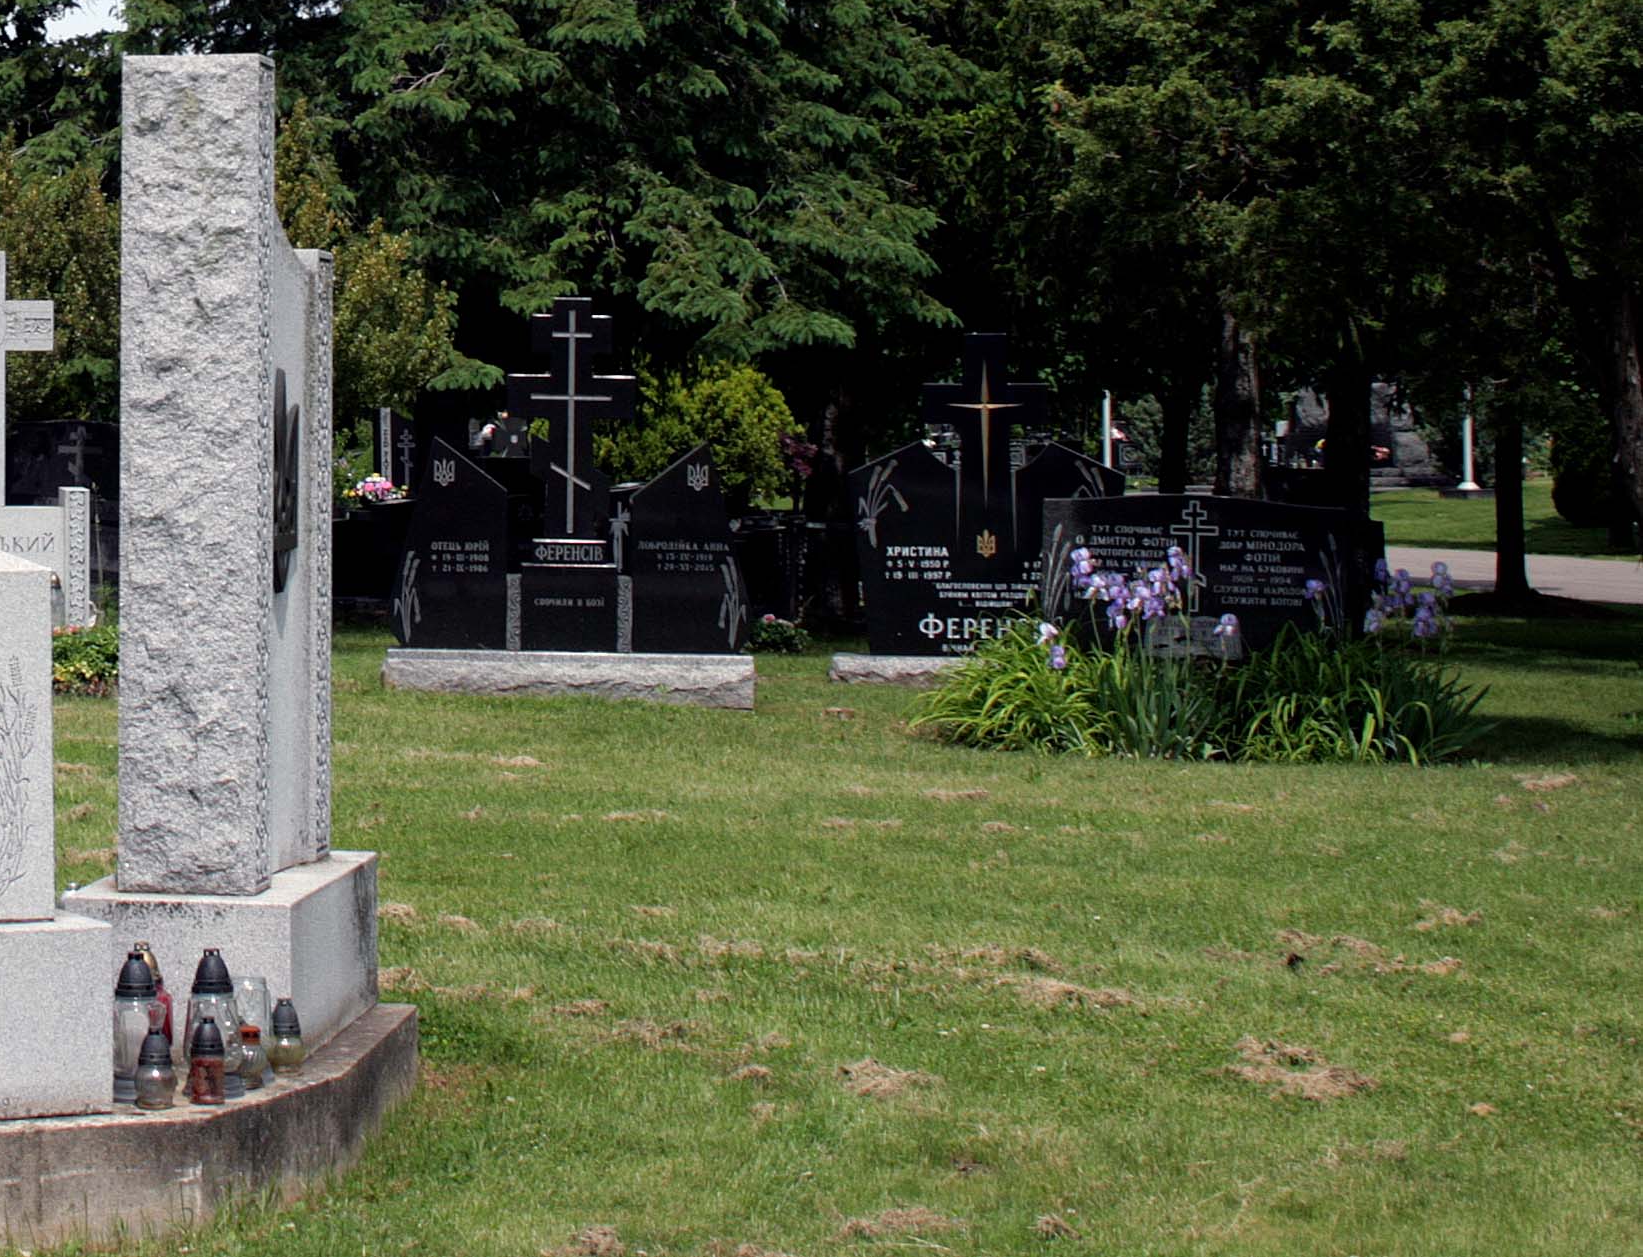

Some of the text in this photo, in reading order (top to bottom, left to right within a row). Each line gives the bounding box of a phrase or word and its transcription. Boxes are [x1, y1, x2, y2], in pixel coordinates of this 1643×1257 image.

[1092, 525, 1109, 533] ТУТ
[1226, 529, 1245, 537] ТУТ
[1090, 536, 1135, 546] ДМИТРО
[535, 544, 604, 561] ФЕРЕНСІВ
[886, 546, 950, 557] ХРИСТИНА
